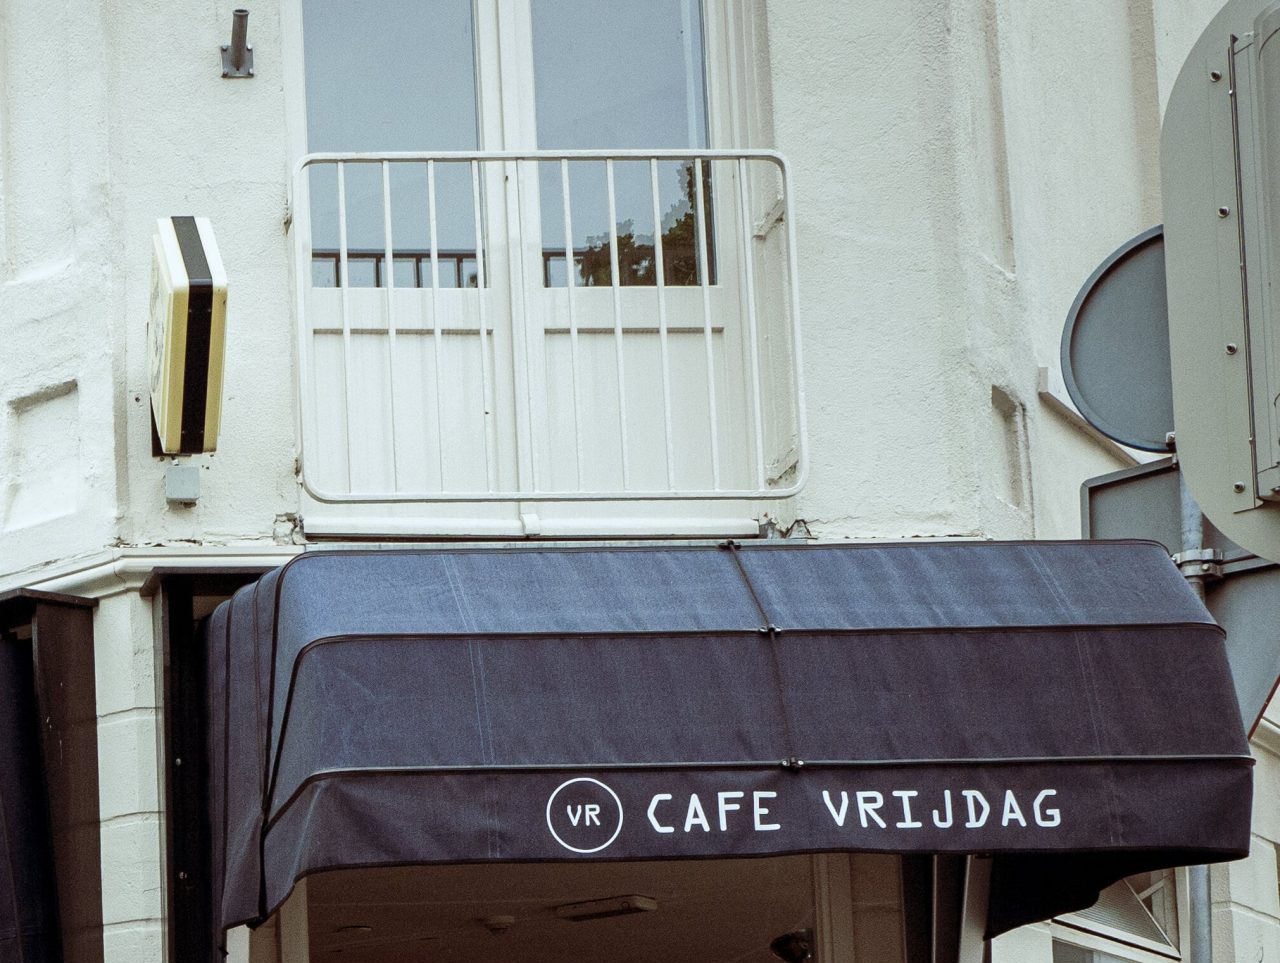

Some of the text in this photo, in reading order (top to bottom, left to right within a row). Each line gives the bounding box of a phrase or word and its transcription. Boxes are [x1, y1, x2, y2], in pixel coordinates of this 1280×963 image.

[566, 804, 601, 827] VR
[647, 789, 1062, 833] CAFE VRIJDAG
